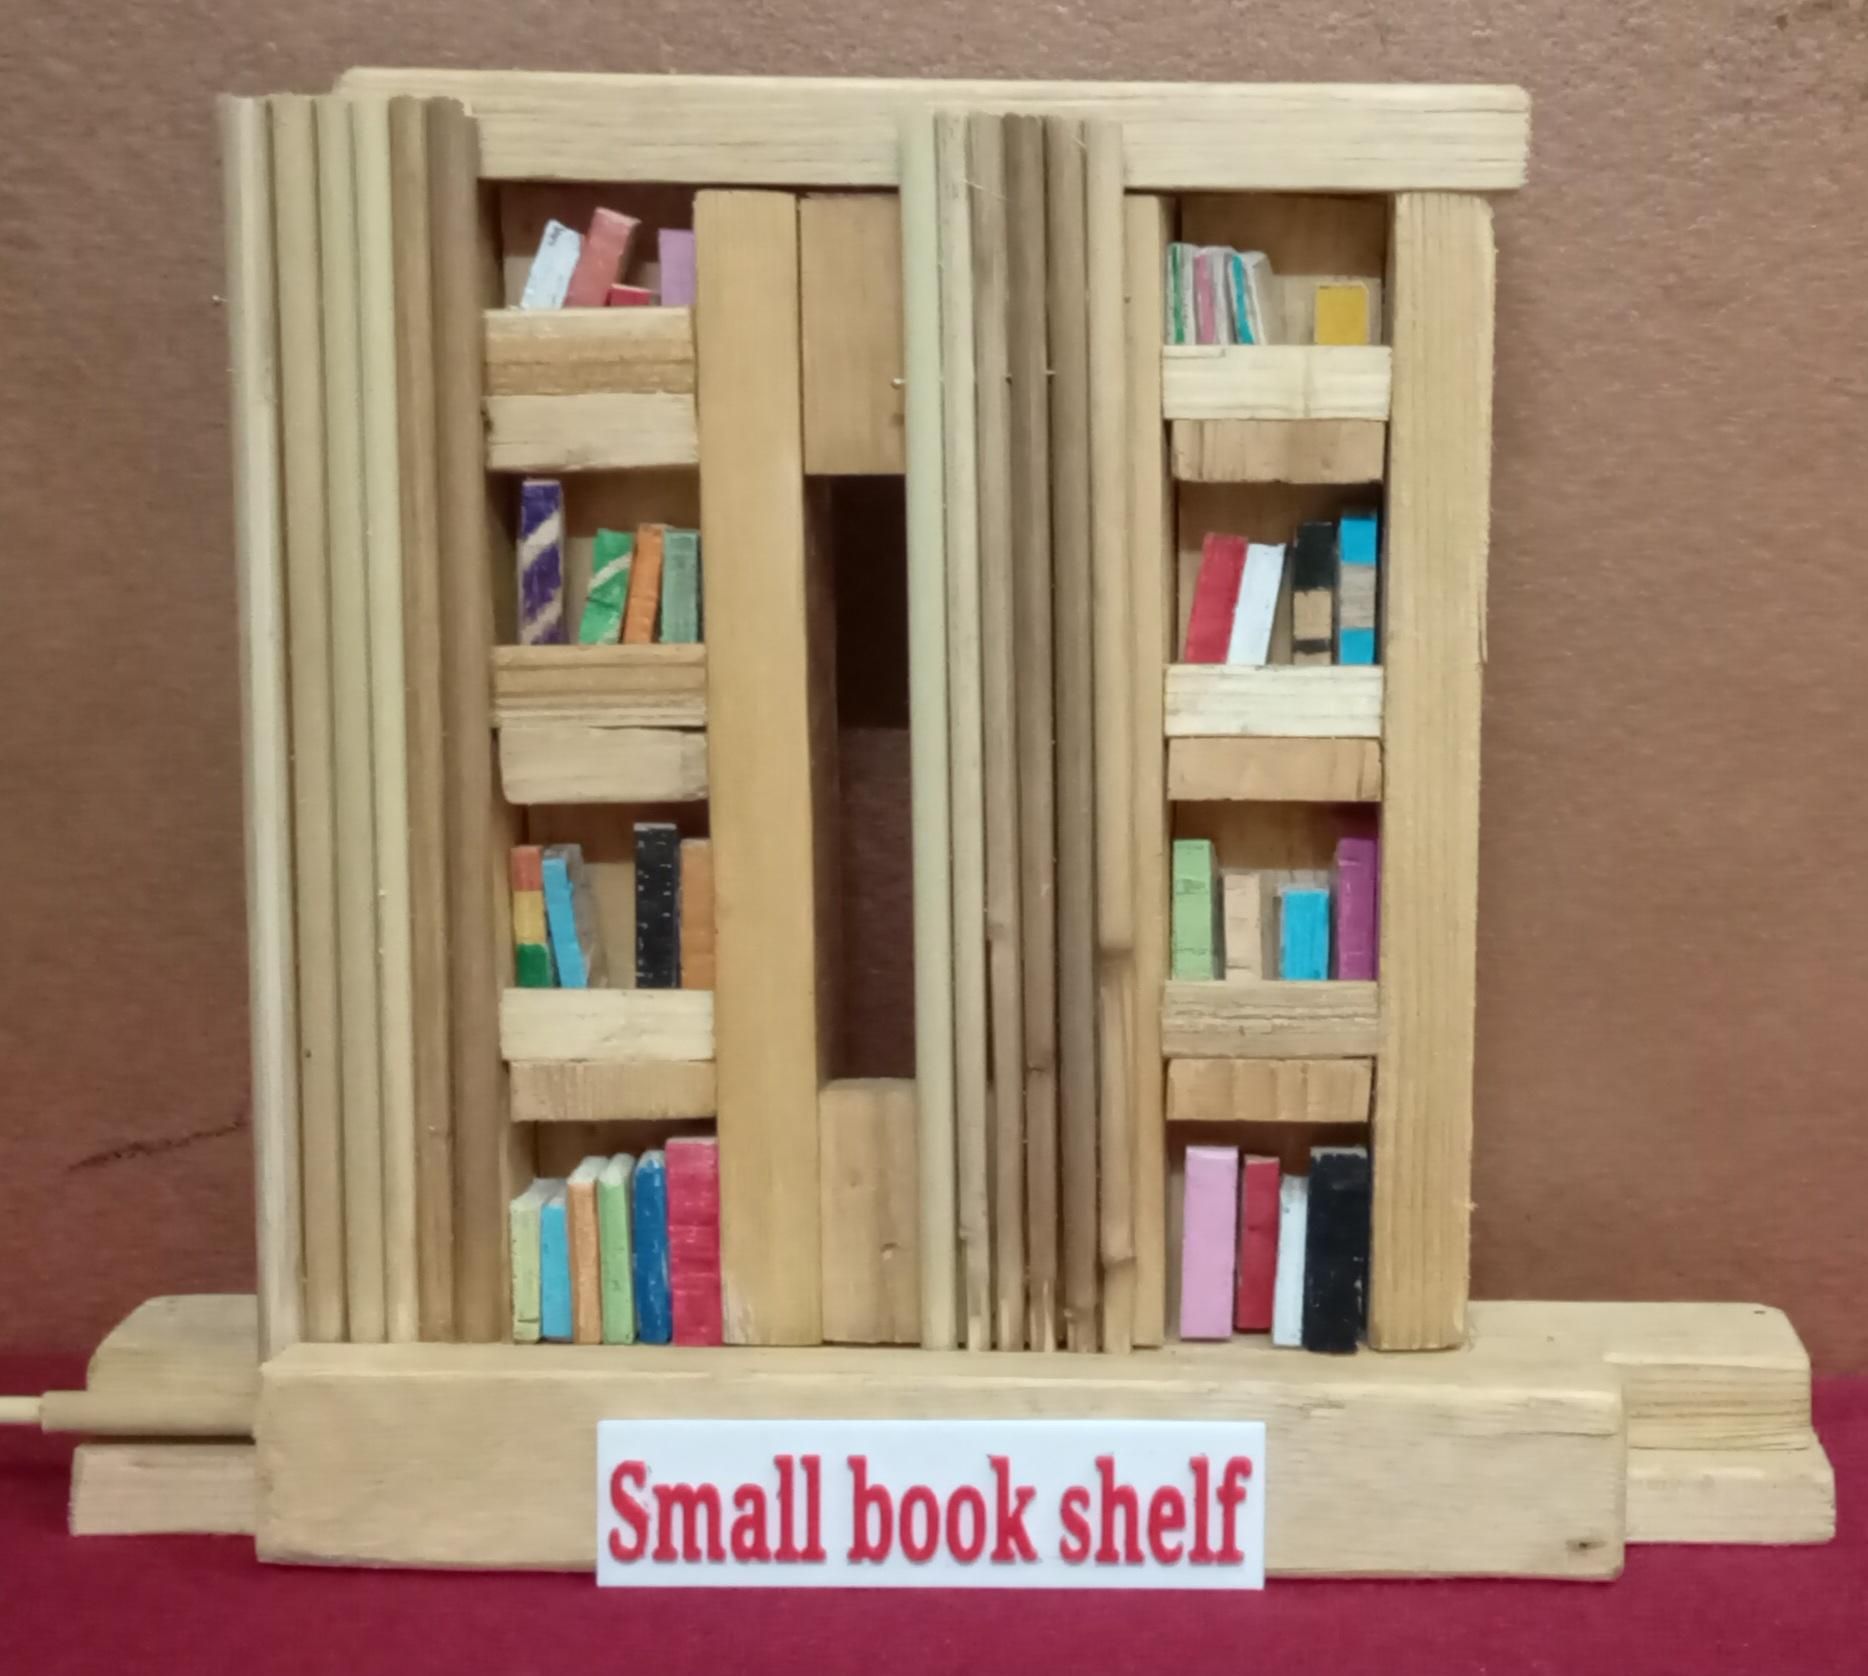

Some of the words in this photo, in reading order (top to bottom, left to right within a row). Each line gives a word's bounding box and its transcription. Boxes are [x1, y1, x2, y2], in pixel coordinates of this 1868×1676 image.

[609, 1454, 826, 1562] Small
[848, 1454, 1038, 1563] book
[1060, 1455, 1253, 1563] shelf
